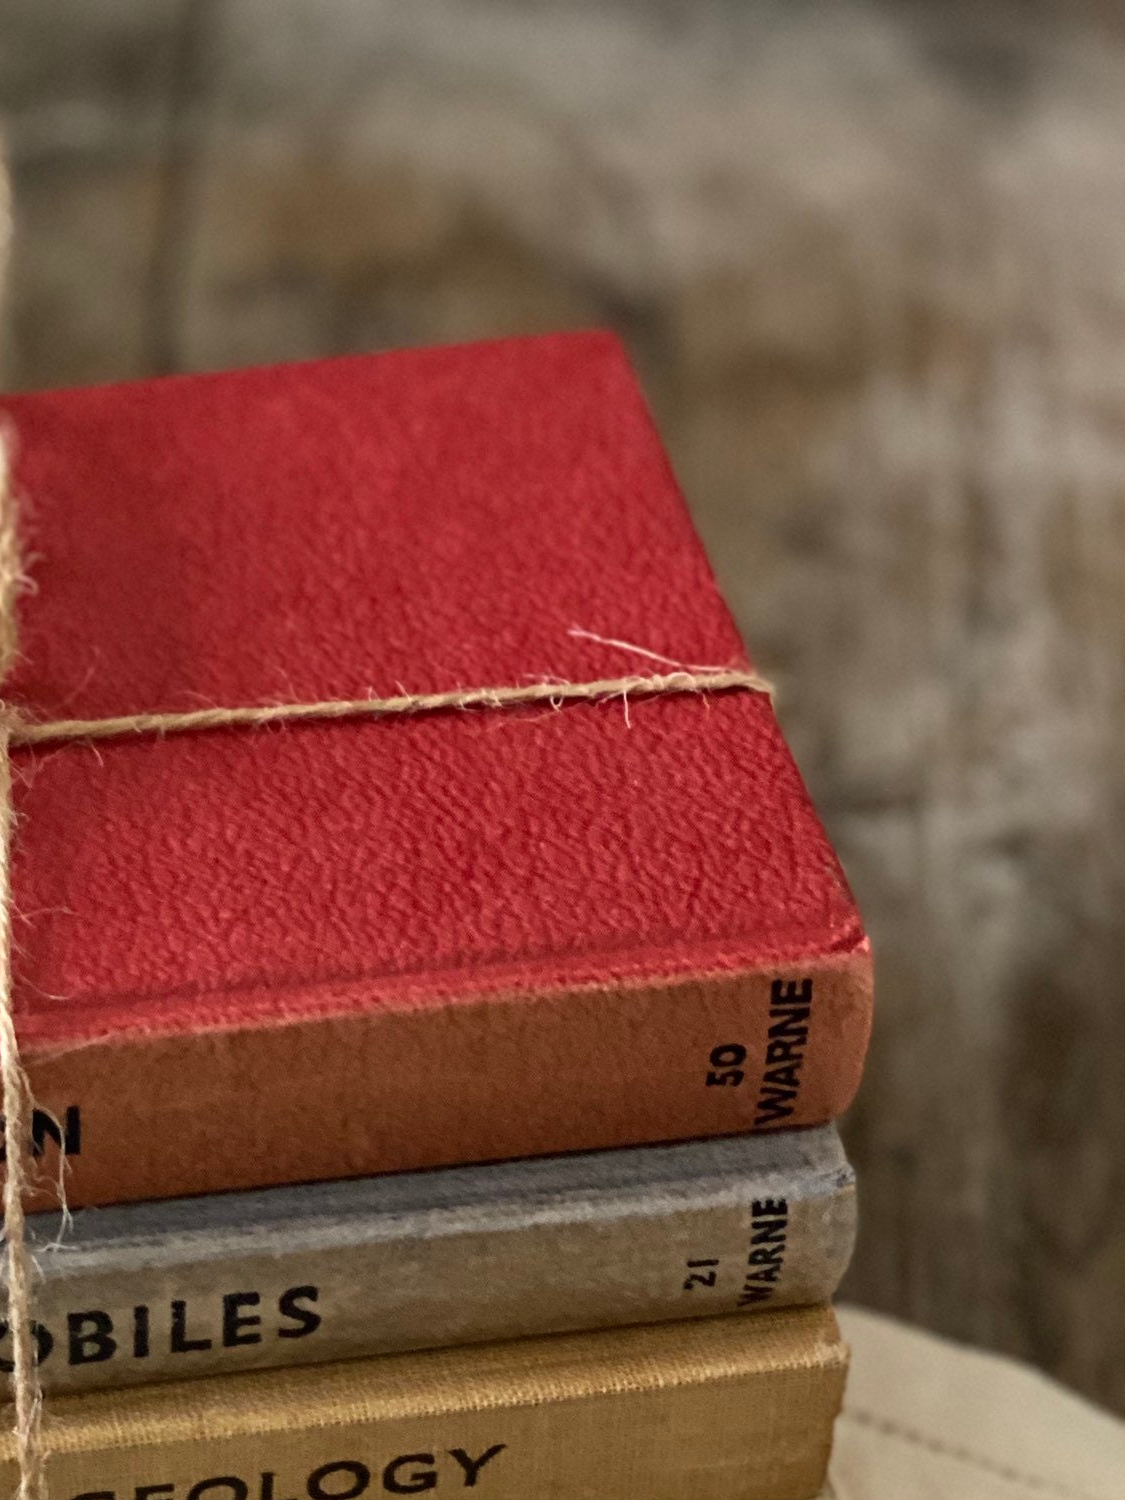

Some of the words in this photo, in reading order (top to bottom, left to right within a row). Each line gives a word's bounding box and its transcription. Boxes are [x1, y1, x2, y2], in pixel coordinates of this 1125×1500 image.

[705, 1043, 748, 1087] 50
[754, 978, 813, 1126] WARNE
[683, 1259, 720, 1291] 21
[737, 1198, 788, 1307] WARNE
